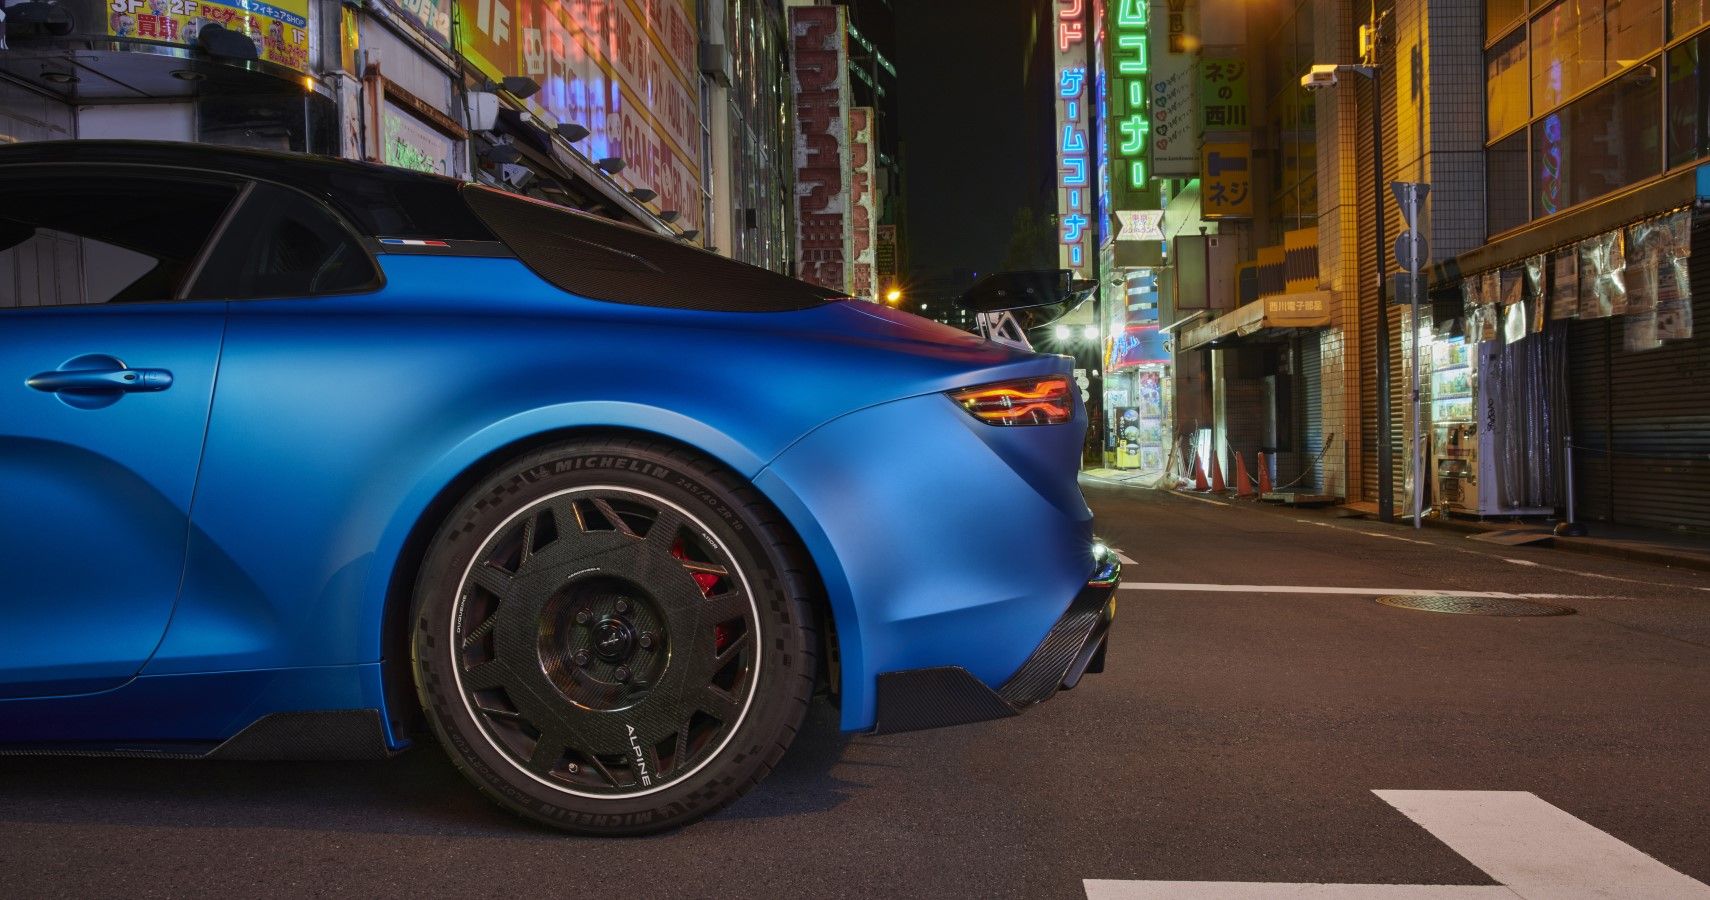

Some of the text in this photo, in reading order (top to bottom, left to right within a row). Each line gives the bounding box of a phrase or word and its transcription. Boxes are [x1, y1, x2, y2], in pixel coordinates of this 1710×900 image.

[138, 14, 178, 40] 買取
[292, 29, 305, 44] 1F
[1206, 62, 1246, 81] ネジ
[1218, 86, 1232, 99] の
[1205, 105, 1246, 126] 西川
[624, 113, 660, 195] GAME
[1061, 67, 1086, 264] ゲームコーナー
[1209, 181, 1247, 207] ネジ
[1269, 300, 1323, 312] 西川電子部品
[555, 456, 669, 480] MICHELIN
[626, 724, 652, 787] ALPINE
